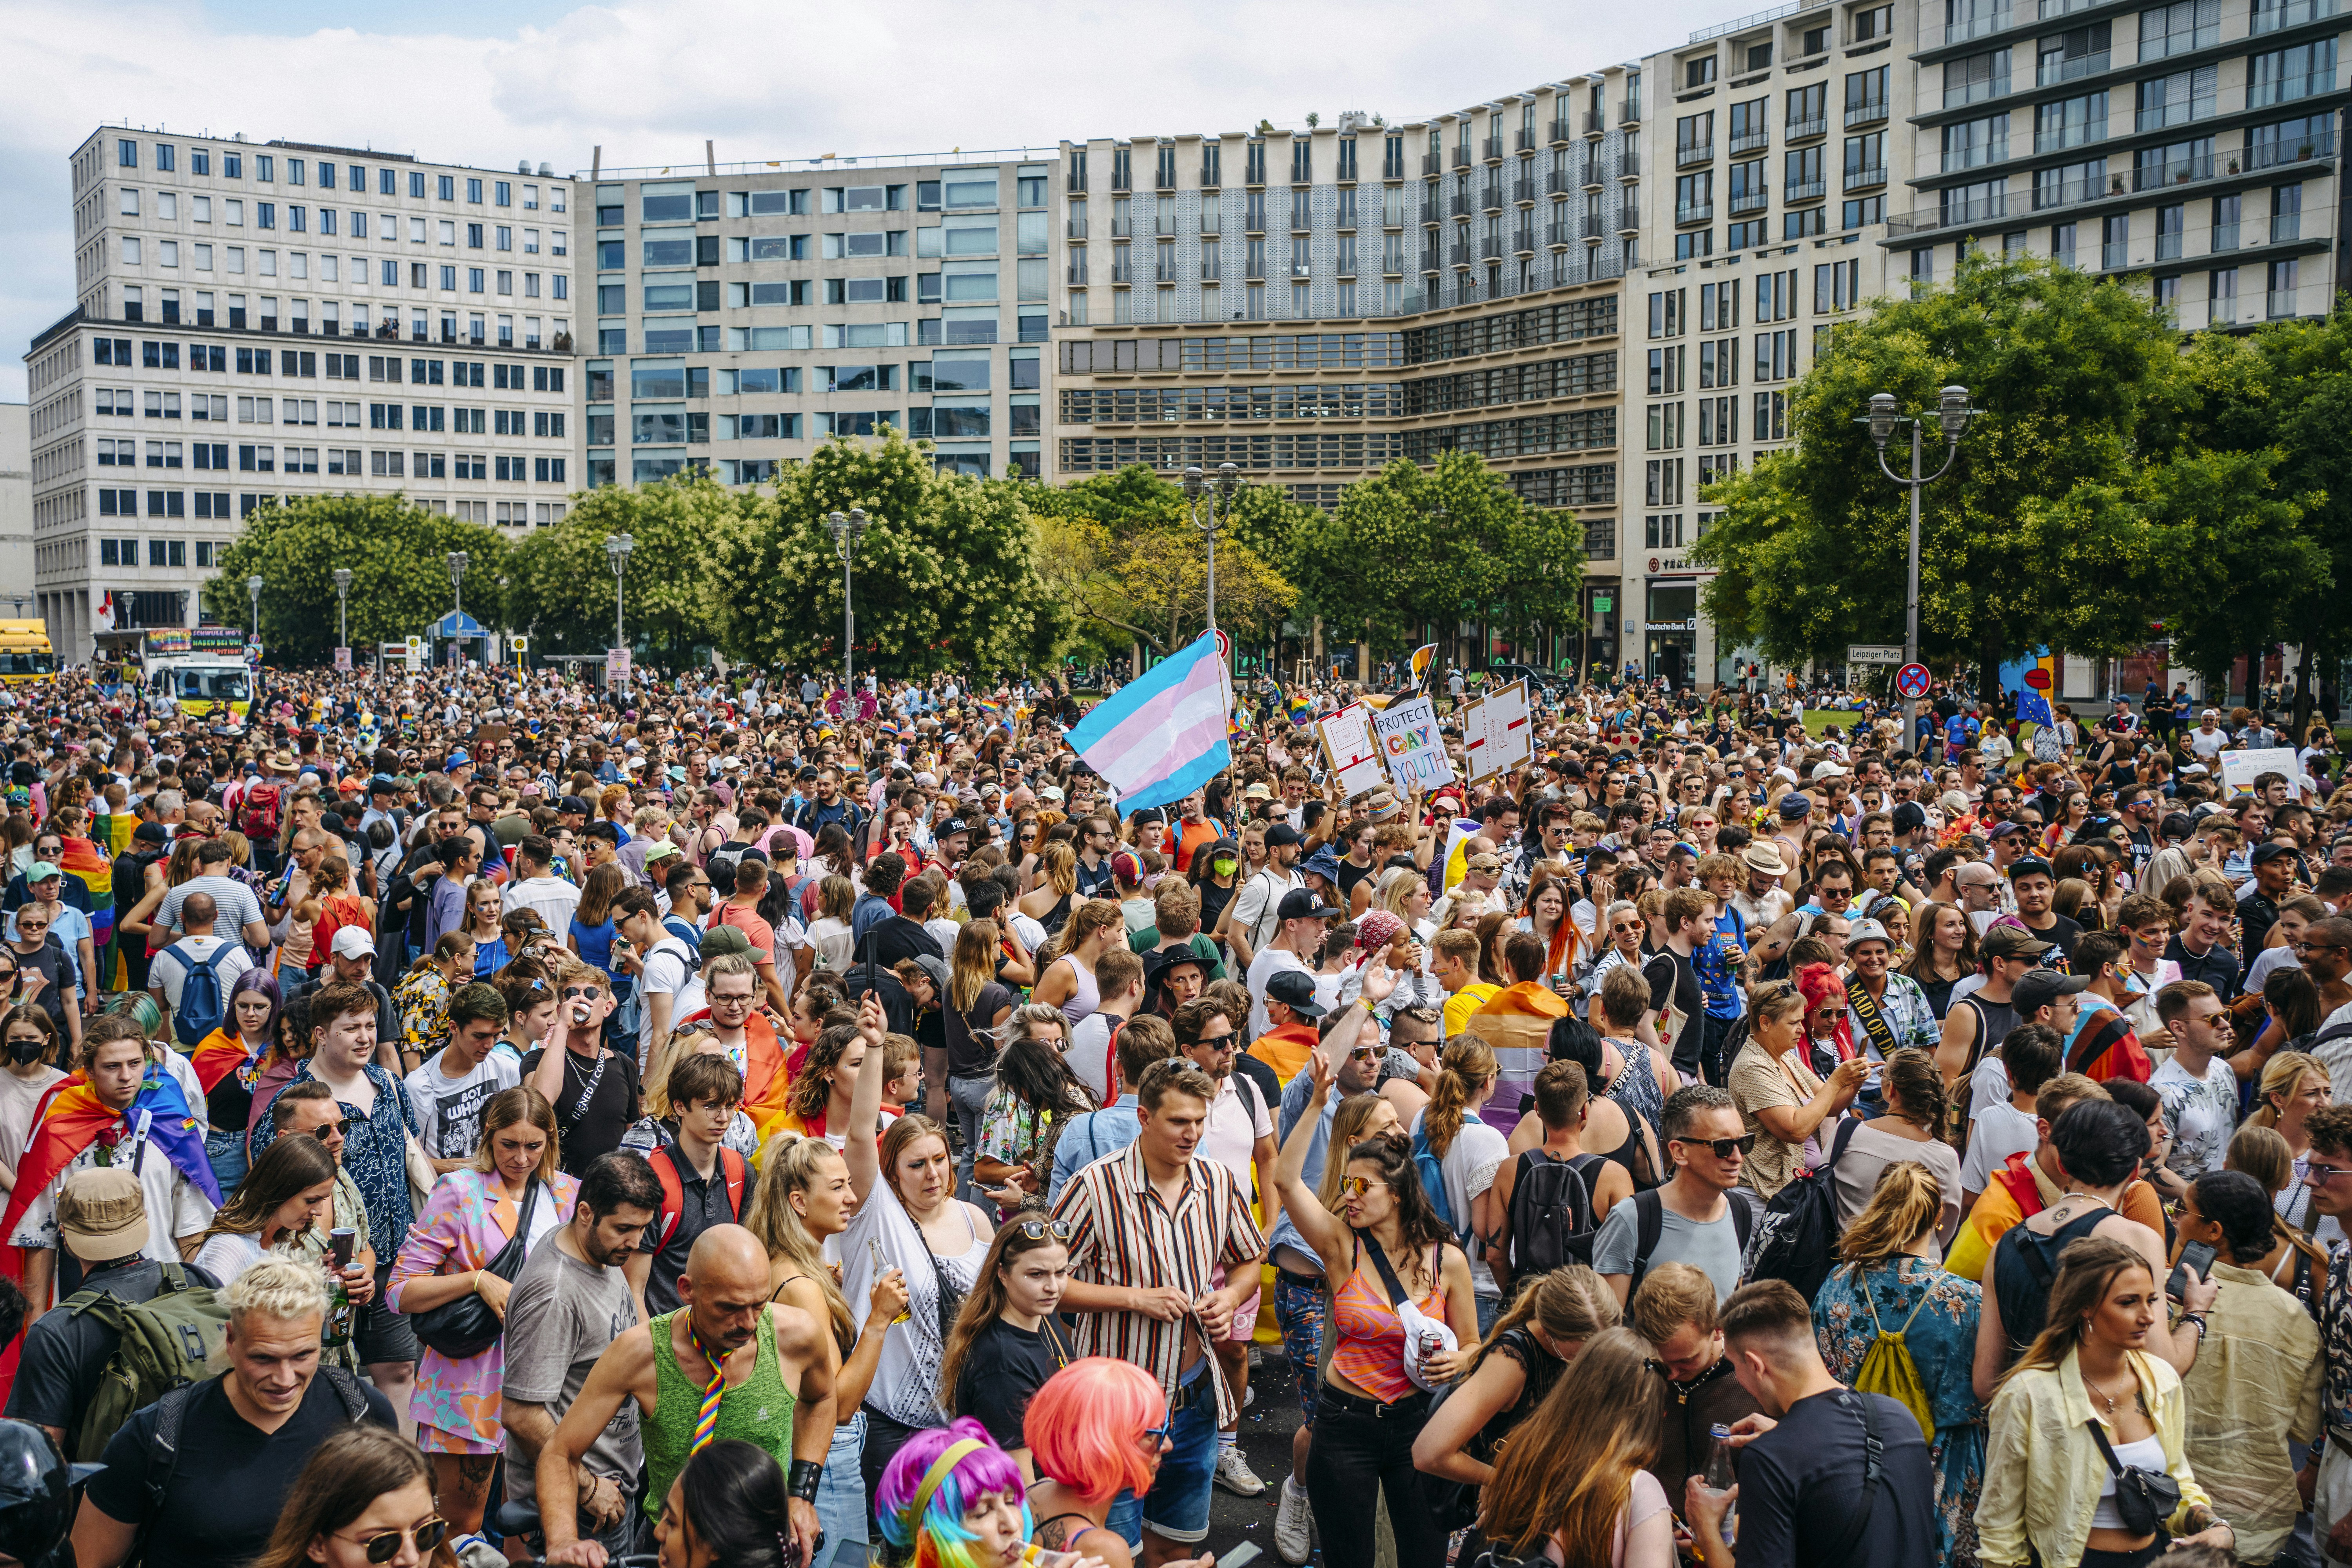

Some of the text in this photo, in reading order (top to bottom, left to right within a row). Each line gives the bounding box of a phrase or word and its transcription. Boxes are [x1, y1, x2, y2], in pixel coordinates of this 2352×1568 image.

[1852, 649, 1900, 659] Leipziger Platz
[1377, 705, 1429, 734] PROTECT
[1387, 724, 1430, 755] GAY
[1393, 750, 1447, 784] YOUTH
[2240, 753, 2281, 761] PROTECT
[1846, 982, 1875, 1018] MAID
[1867, 1018, 1889, 1041] OF
[461, 1085, 482, 1103] BOY
[108, 1253, 139, 1267] Canon
[614, 1408, 635, 1433] Full
